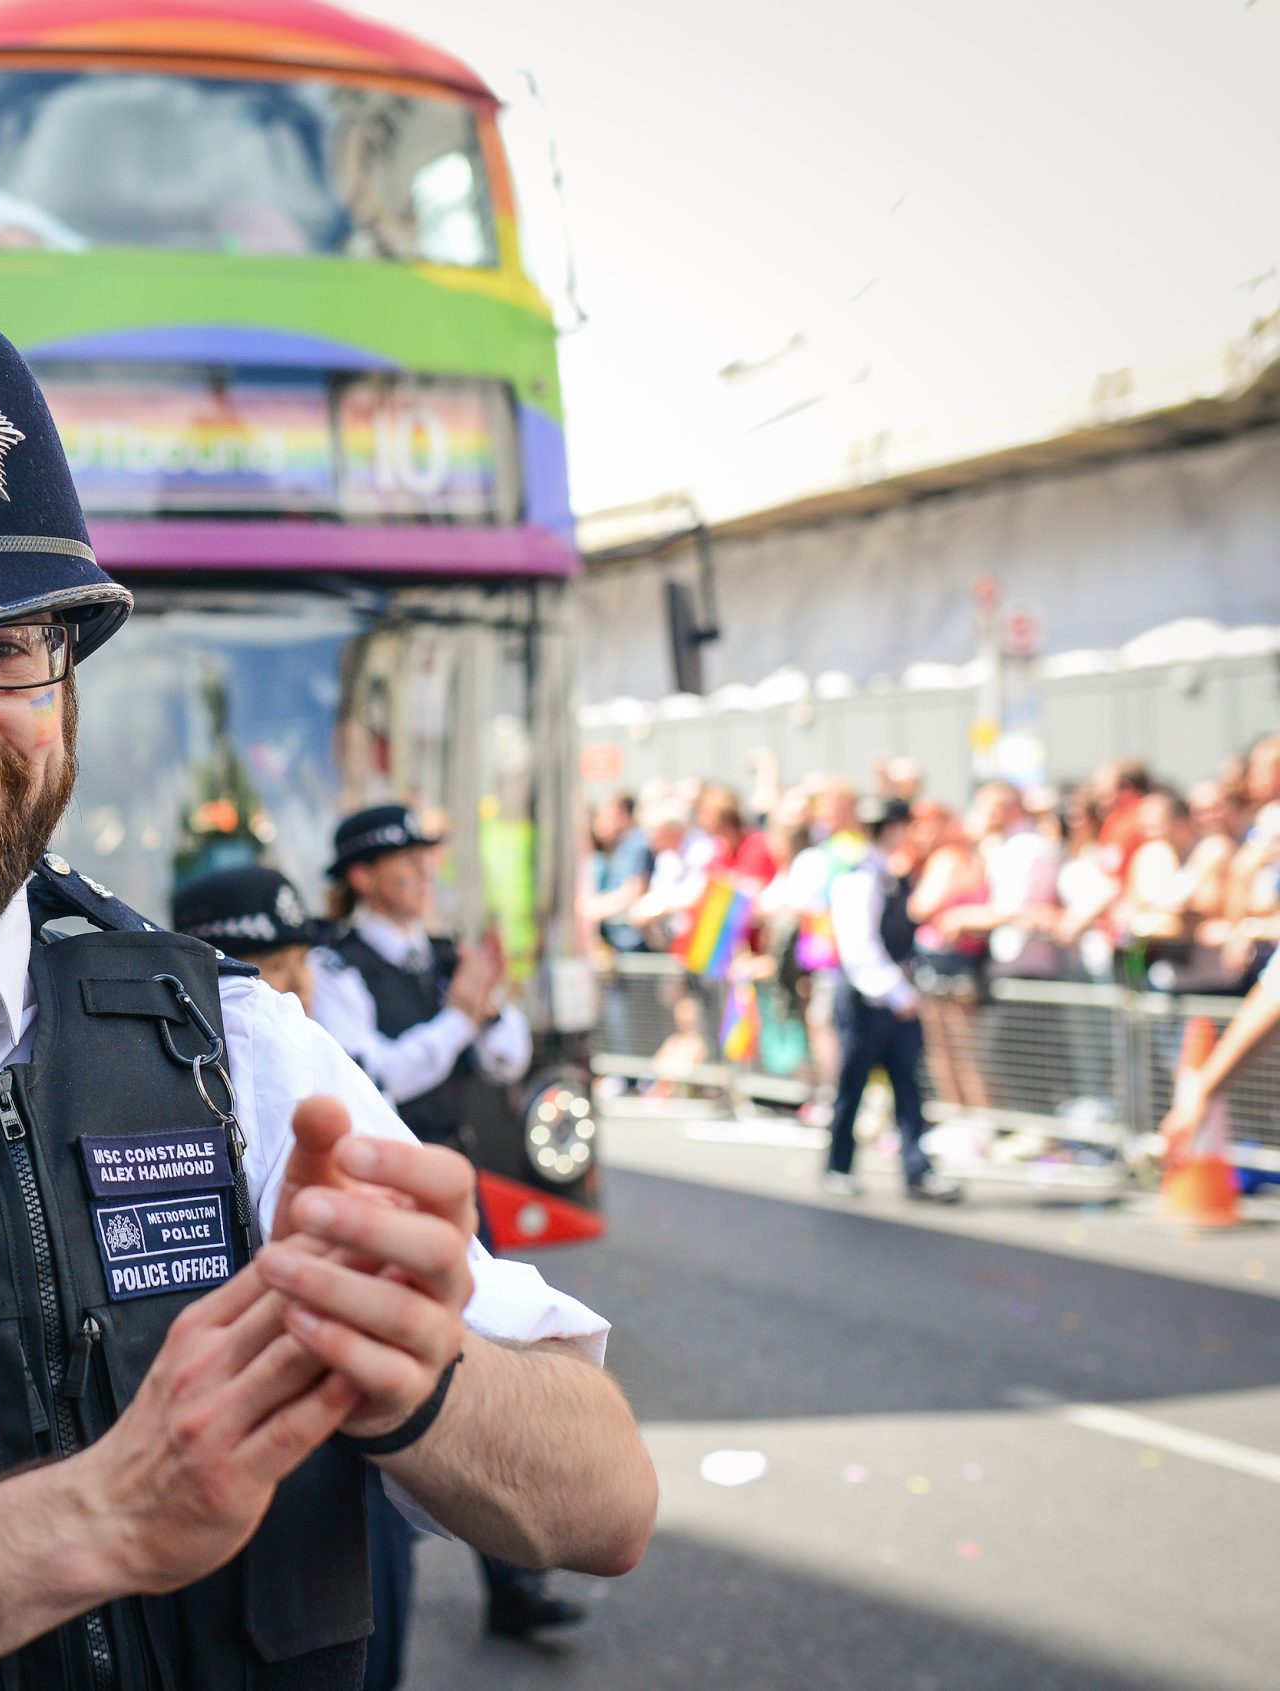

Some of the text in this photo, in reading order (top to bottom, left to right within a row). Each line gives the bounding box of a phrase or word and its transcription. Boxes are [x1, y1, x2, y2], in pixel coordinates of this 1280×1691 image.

[372, 402, 450, 494] 10
[93, 1142, 216, 1165] MSC CONSTABLE
[100, 1160, 215, 1182] ALEX HAMMOND
[146, 1206, 216, 1225] METROPOLITAN
[161, 1224, 211, 1242] POLICE
[111, 1255, 229, 1293] POLICE OFFICER
